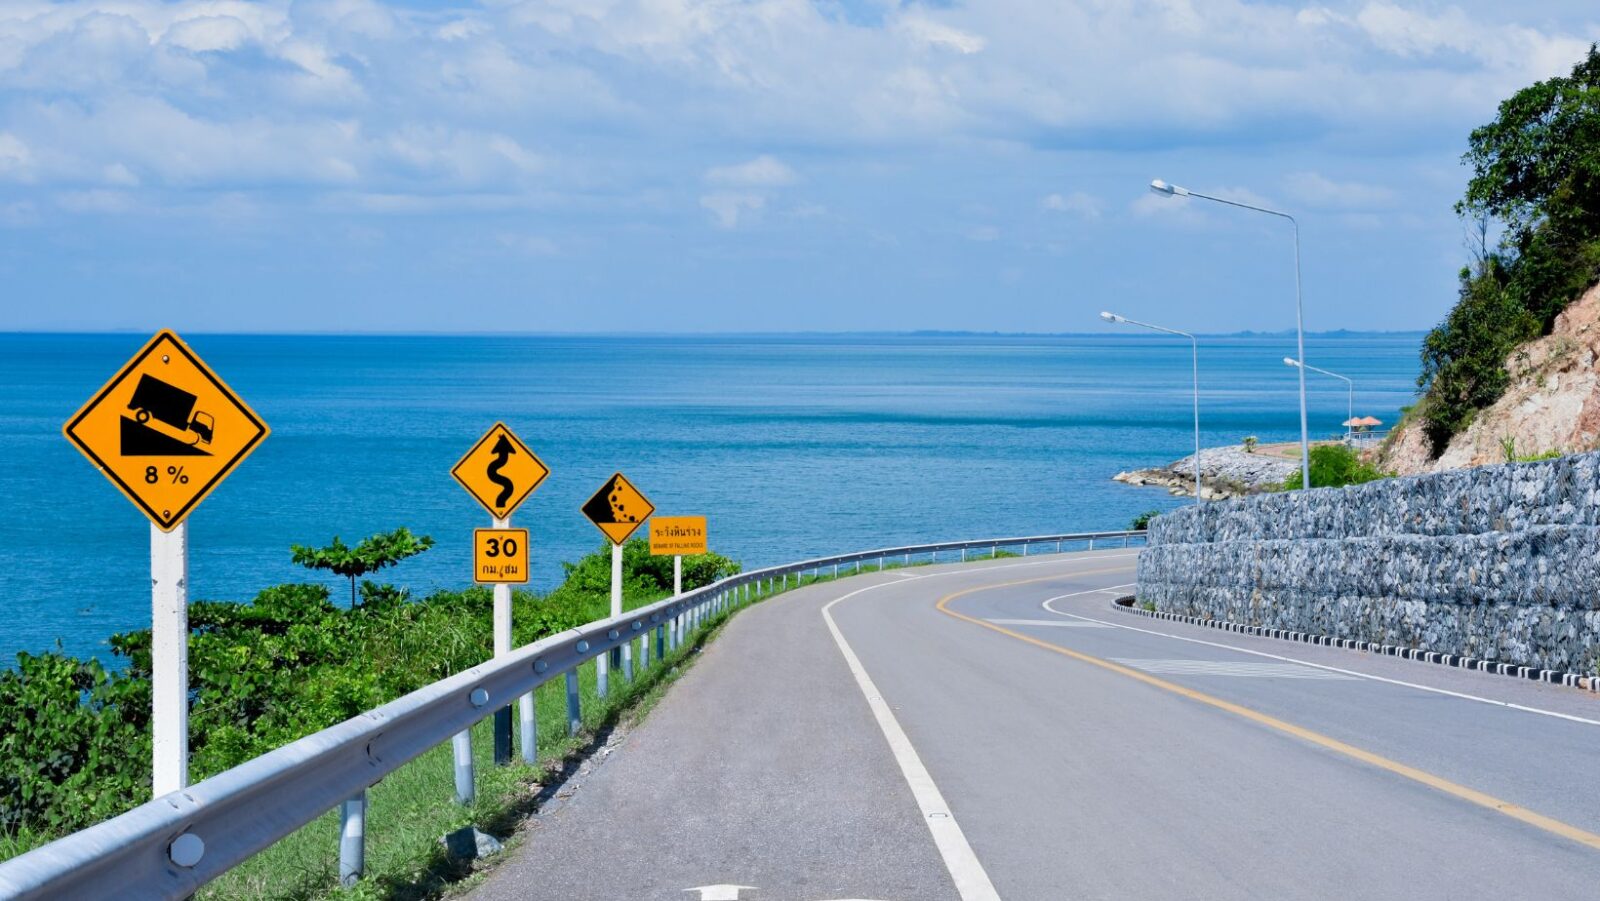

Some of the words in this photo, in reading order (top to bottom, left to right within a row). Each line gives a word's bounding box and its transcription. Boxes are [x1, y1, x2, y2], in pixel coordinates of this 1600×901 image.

[145, 465, 158, 484] 8
[167, 465, 189, 484] %
[485, 538, 518, 558] 30
